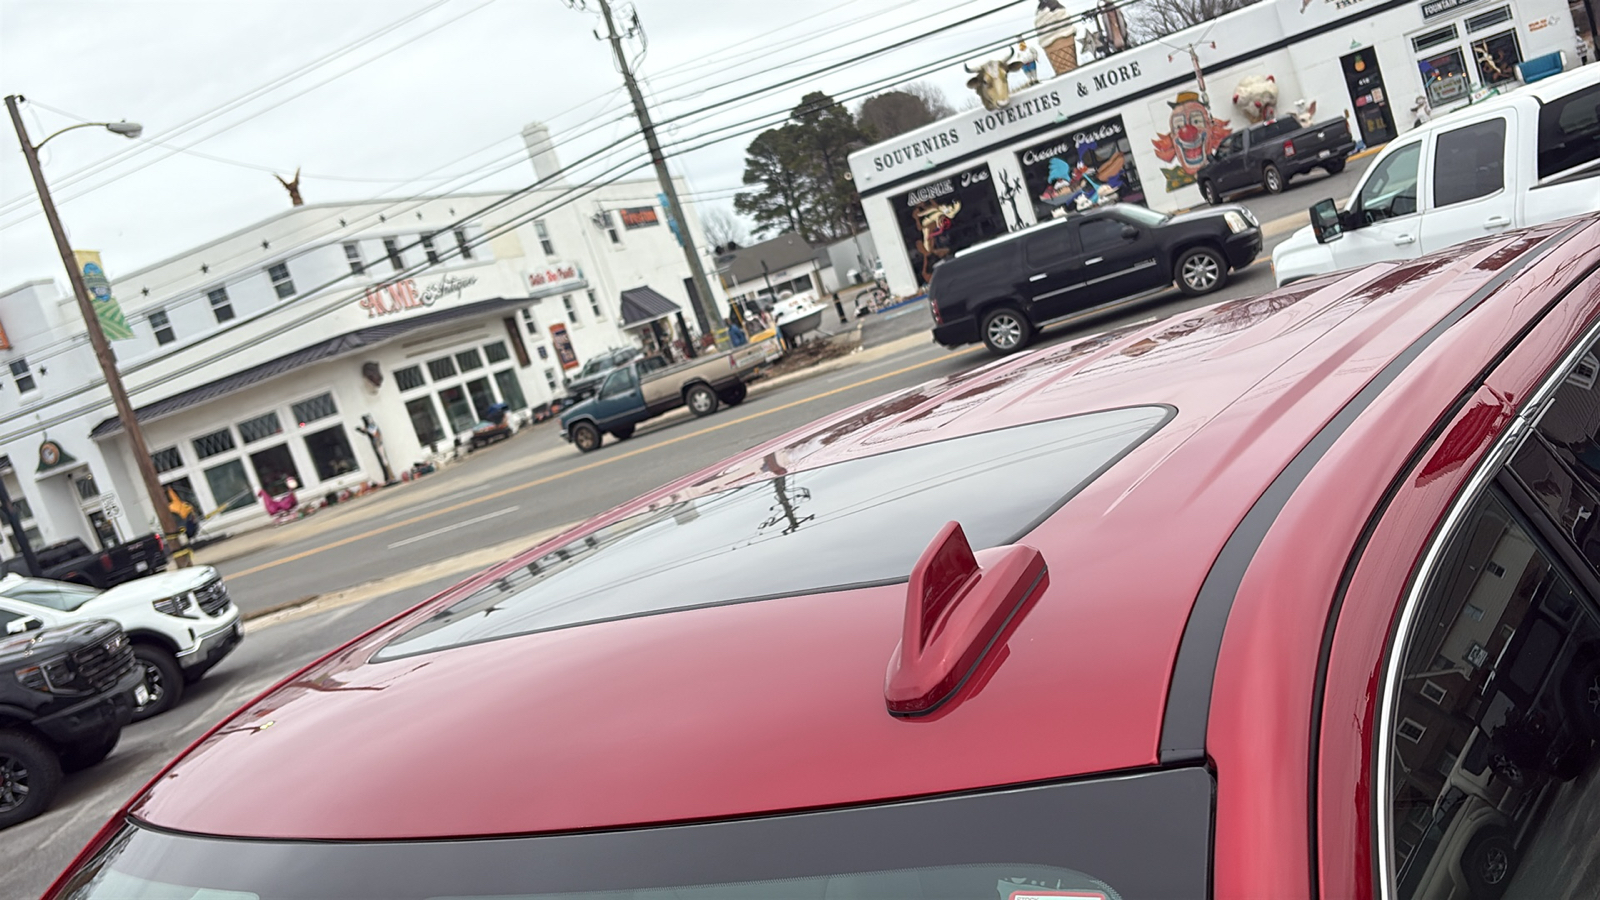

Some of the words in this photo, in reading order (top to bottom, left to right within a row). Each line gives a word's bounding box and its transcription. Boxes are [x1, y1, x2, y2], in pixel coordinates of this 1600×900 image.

[874, 127, 960, 172] SOUVENIRS
[972, 91, 1062, 136] NOVELTIES
[1075, 82, 1089, 98] &
[1094, 61, 1143, 92] MORE
[1022, 141, 1069, 167] Cream
[1073, 120, 1123, 149] Parlor
[907, 179, 955, 207] ACME
[960, 167, 990, 188] Ice
[359, 278, 423, 319] ACME
